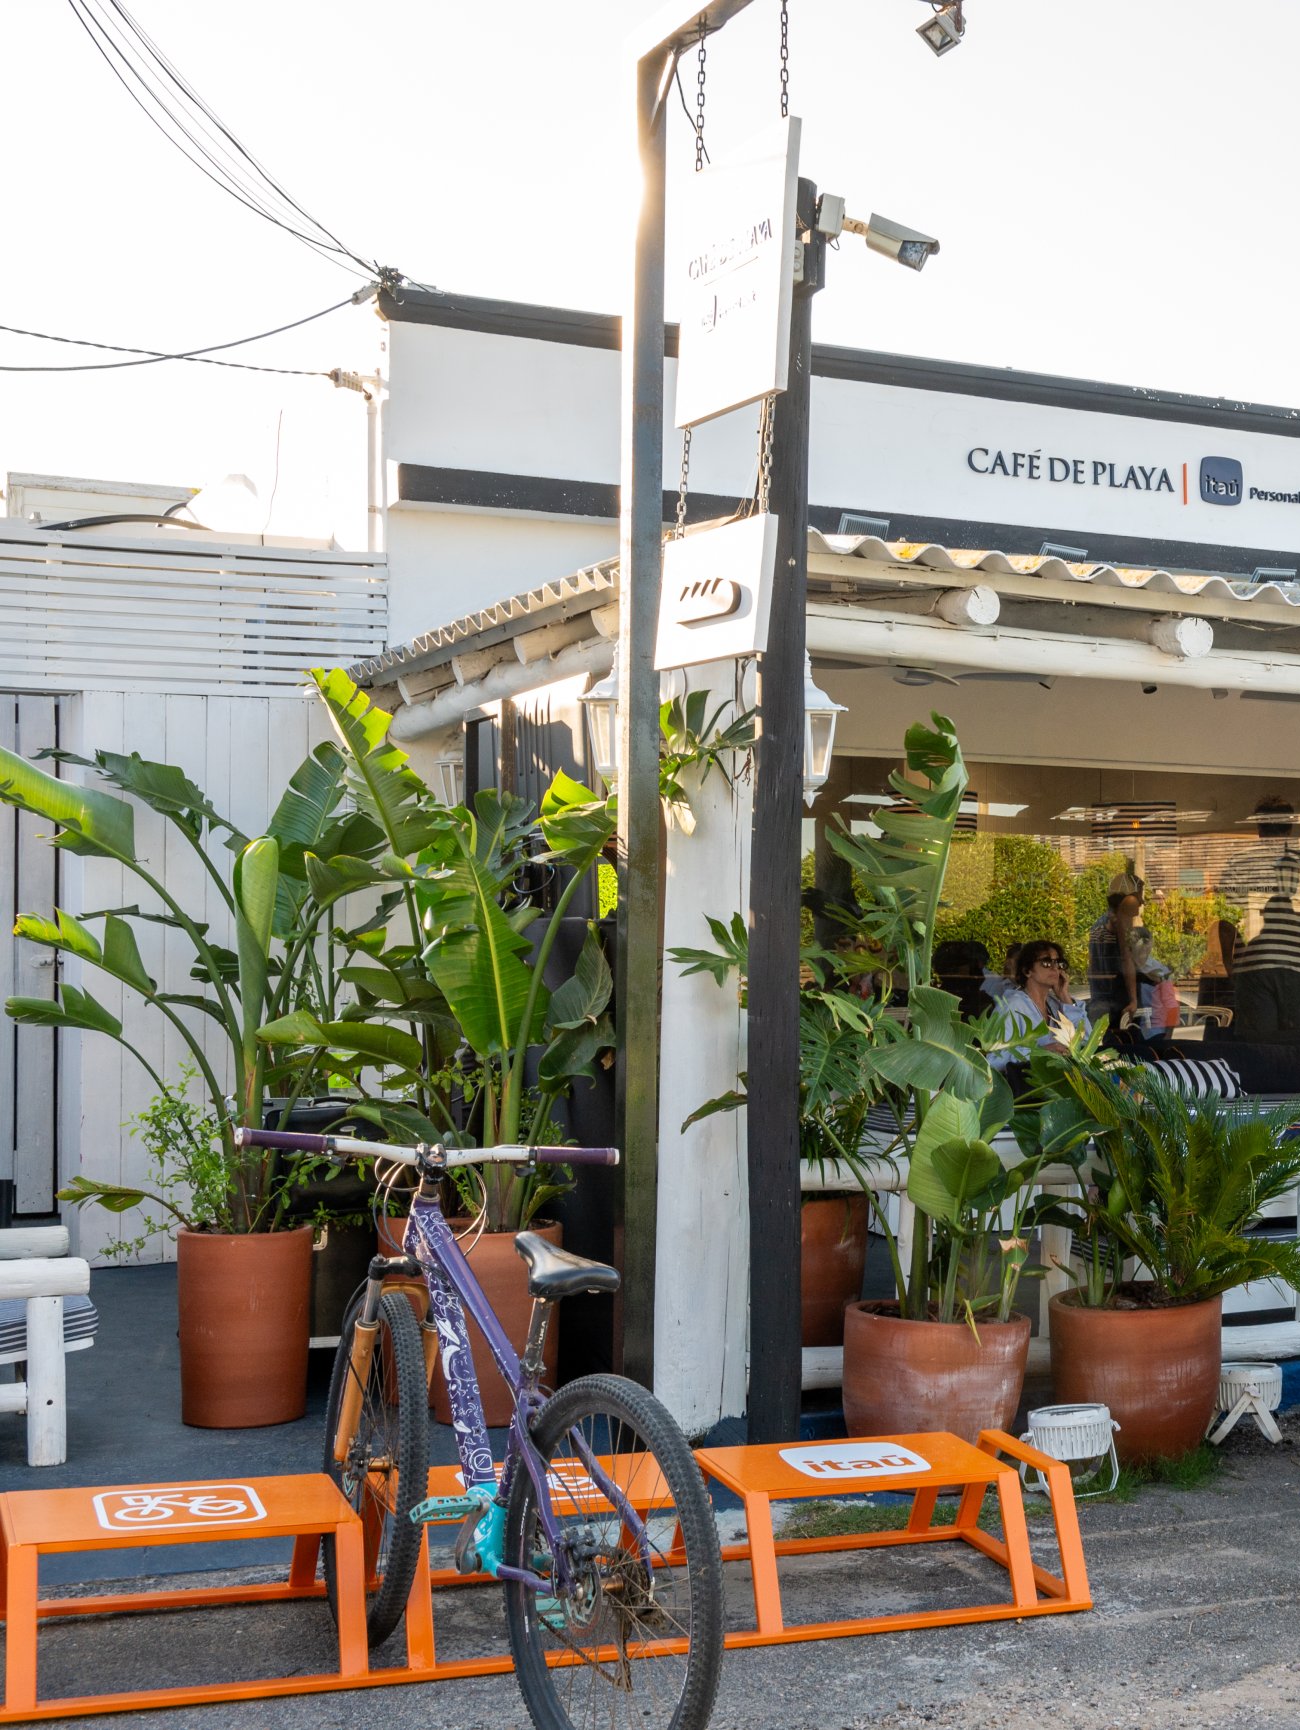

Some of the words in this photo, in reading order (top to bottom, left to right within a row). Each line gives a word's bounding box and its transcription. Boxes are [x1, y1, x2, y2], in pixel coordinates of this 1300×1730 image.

[967, 447, 1042, 480] CAFÉ
[1048, 456, 1086, 484] DE
[1091, 460, 1176, 493] PLAYA
[1204, 474, 1240, 498] itaú
[802, 1454, 917, 1473] itaú
